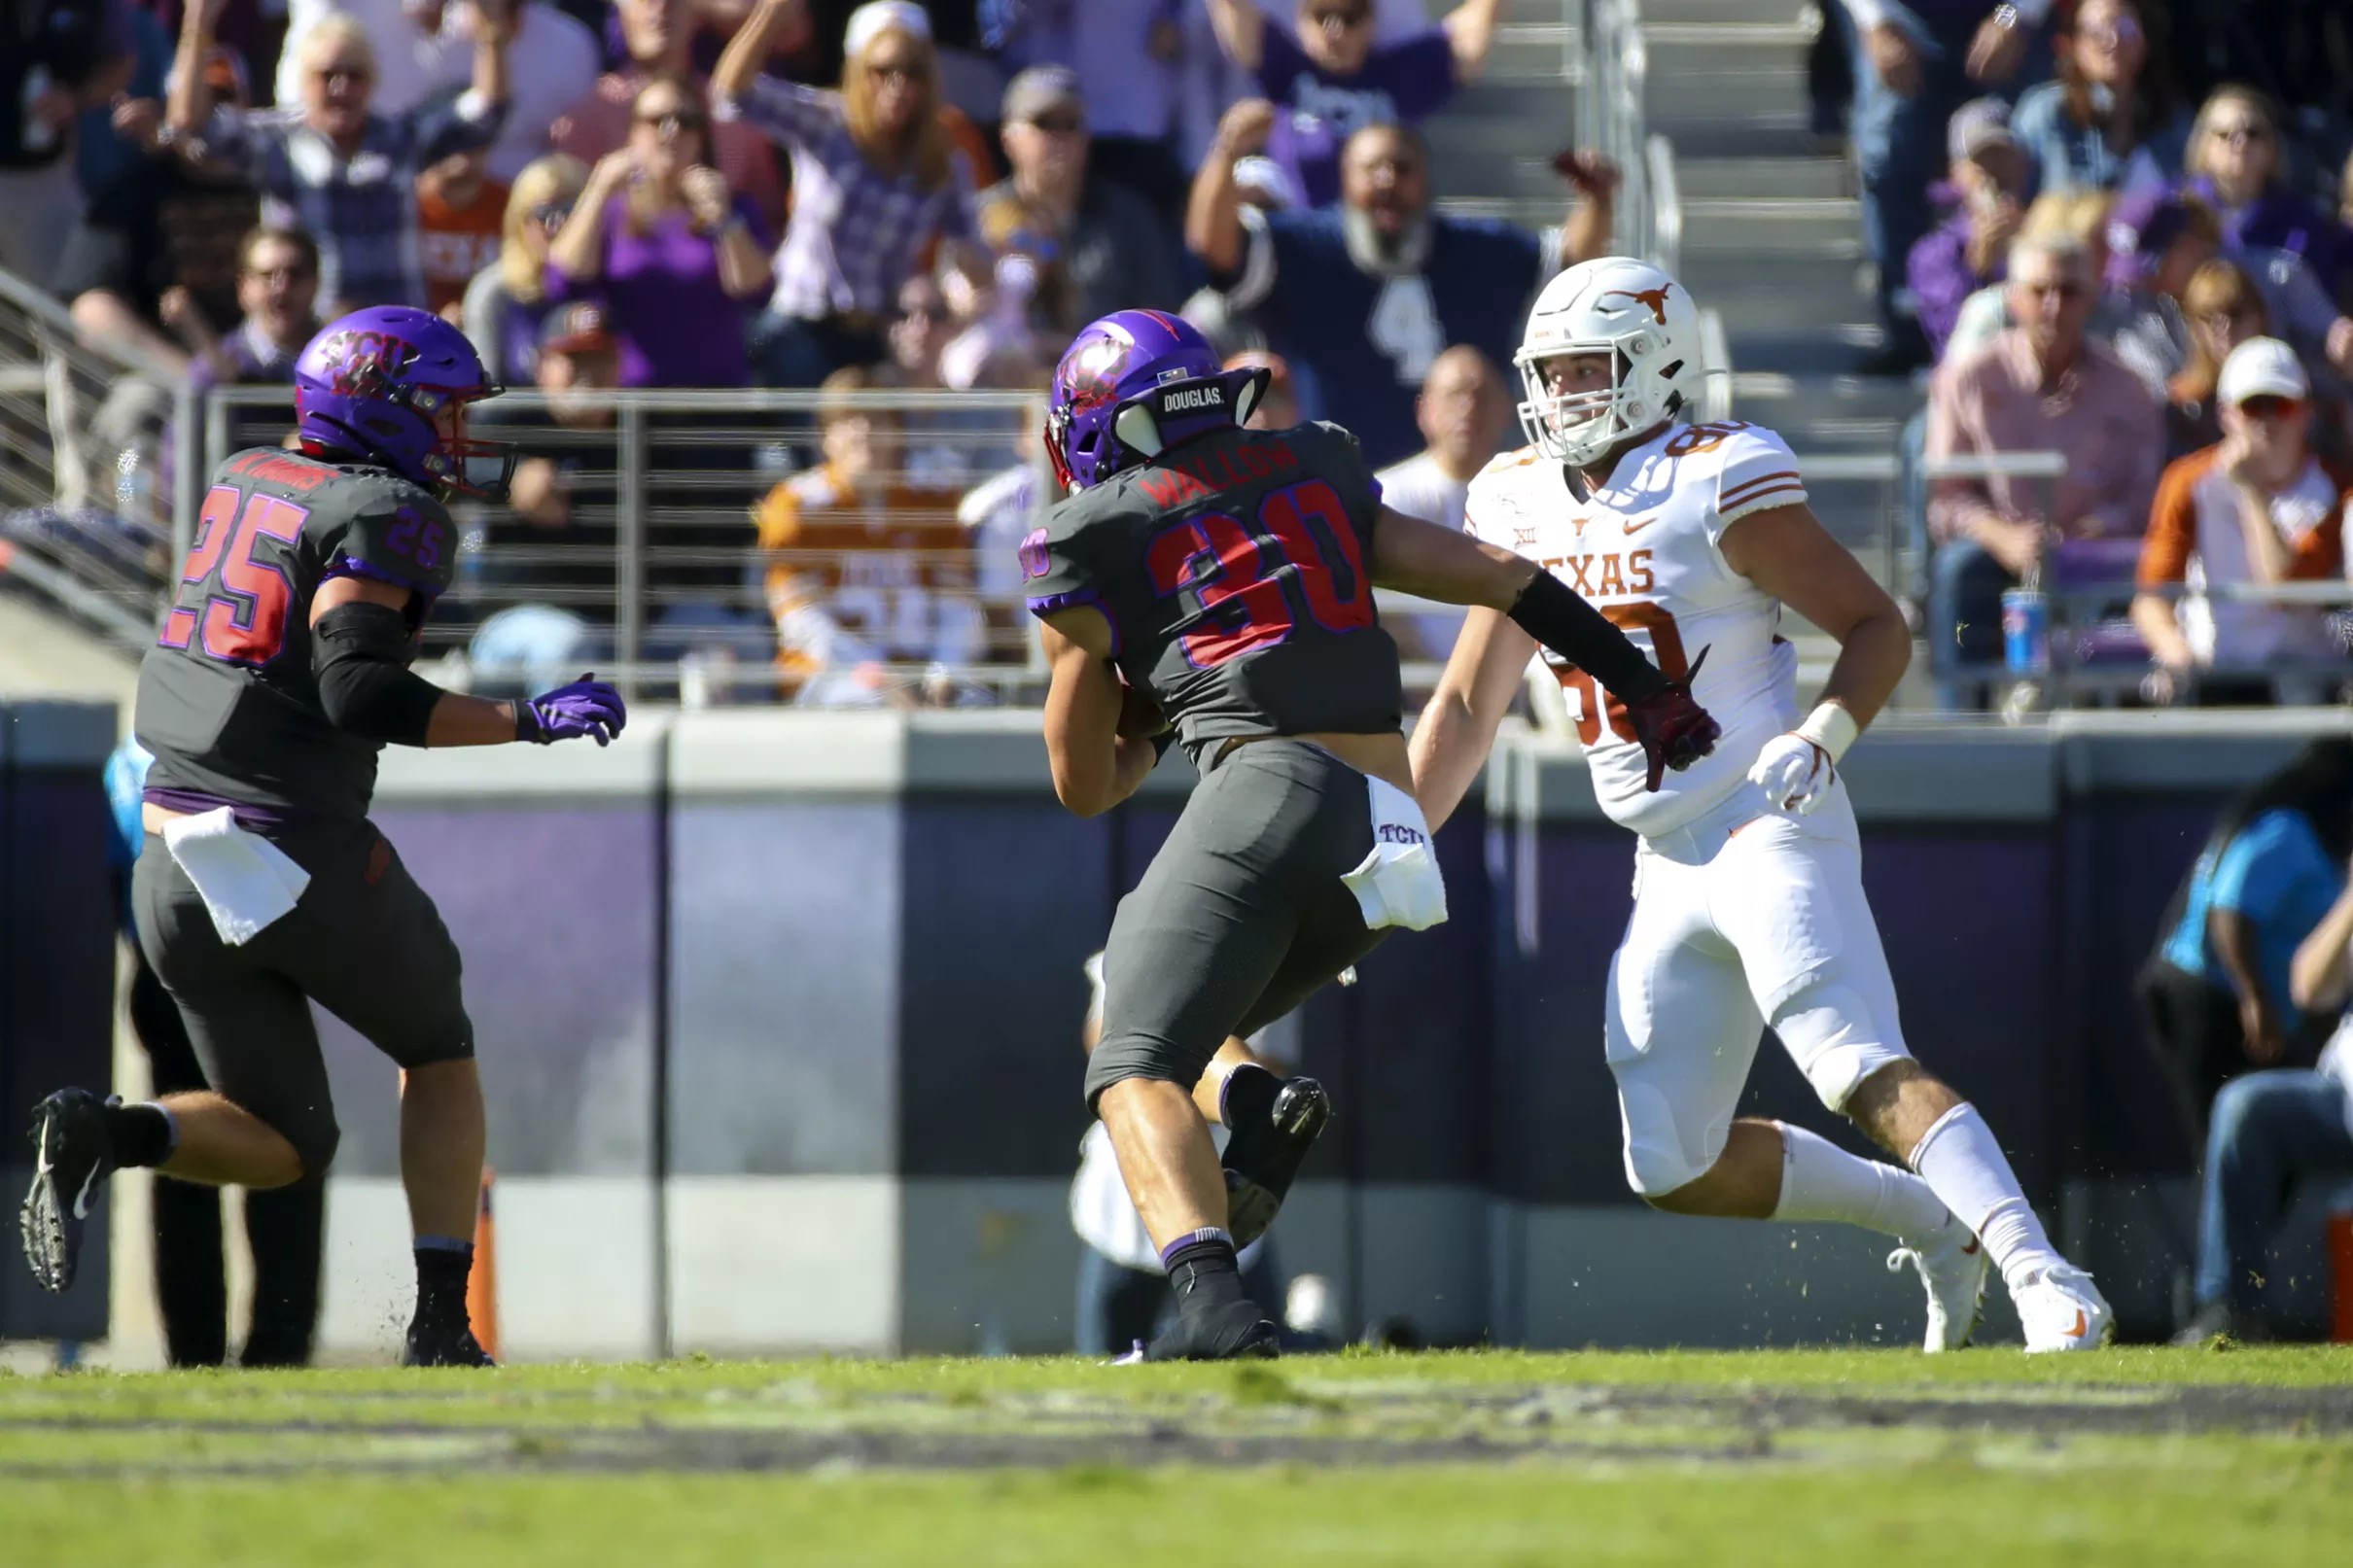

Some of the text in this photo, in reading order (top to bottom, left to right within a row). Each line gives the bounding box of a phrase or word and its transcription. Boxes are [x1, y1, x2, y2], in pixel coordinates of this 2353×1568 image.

[1164, 387, 1221, 412] DOUGLAS
[1140, 438, 1299, 508] WALLOW
[386, 505, 444, 569] 25
[158, 484, 311, 668] 25
[1144, 477, 1375, 669] 30
